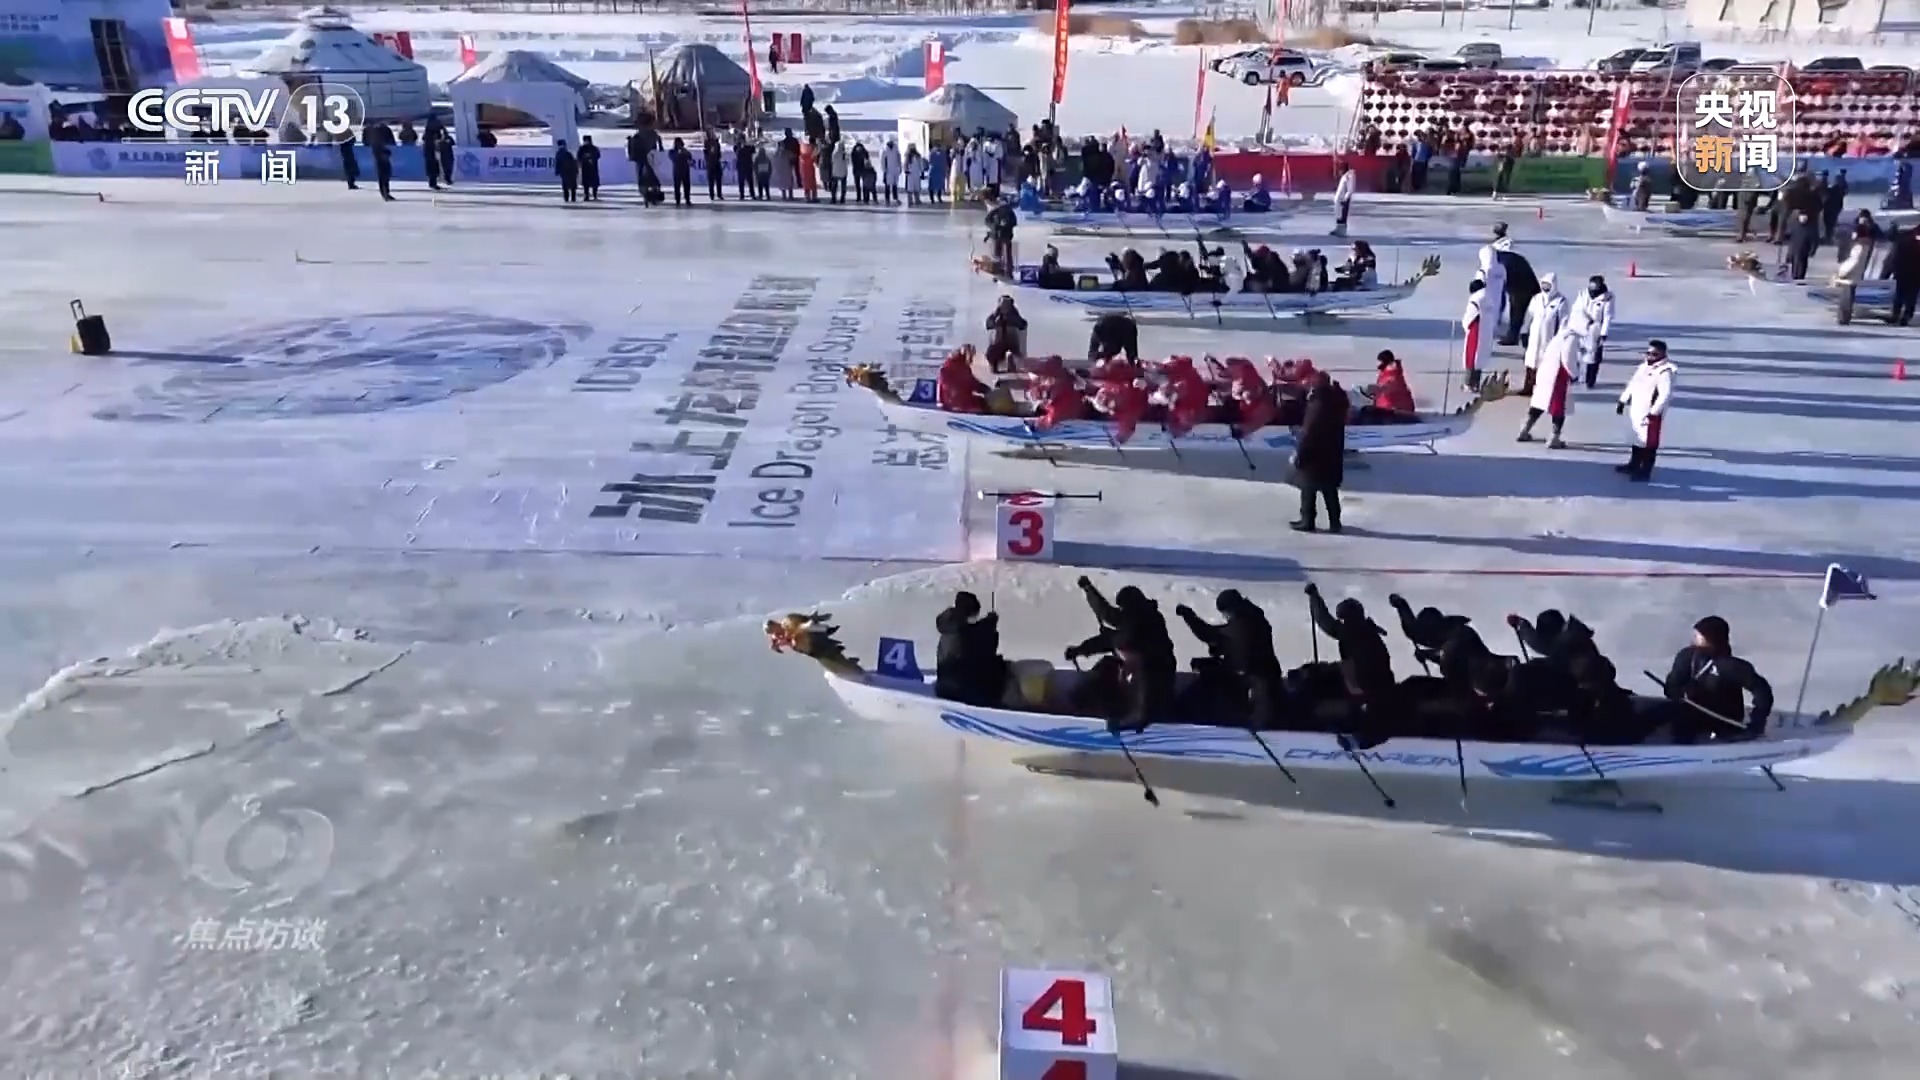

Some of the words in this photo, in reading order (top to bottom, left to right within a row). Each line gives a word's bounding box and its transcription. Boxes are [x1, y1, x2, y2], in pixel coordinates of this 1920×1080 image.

[918, 382, 934, 399] 3
[1008, 511, 1044, 556] 3
[884, 642, 907, 671] 4
[1022, 979, 1097, 1046] 4
